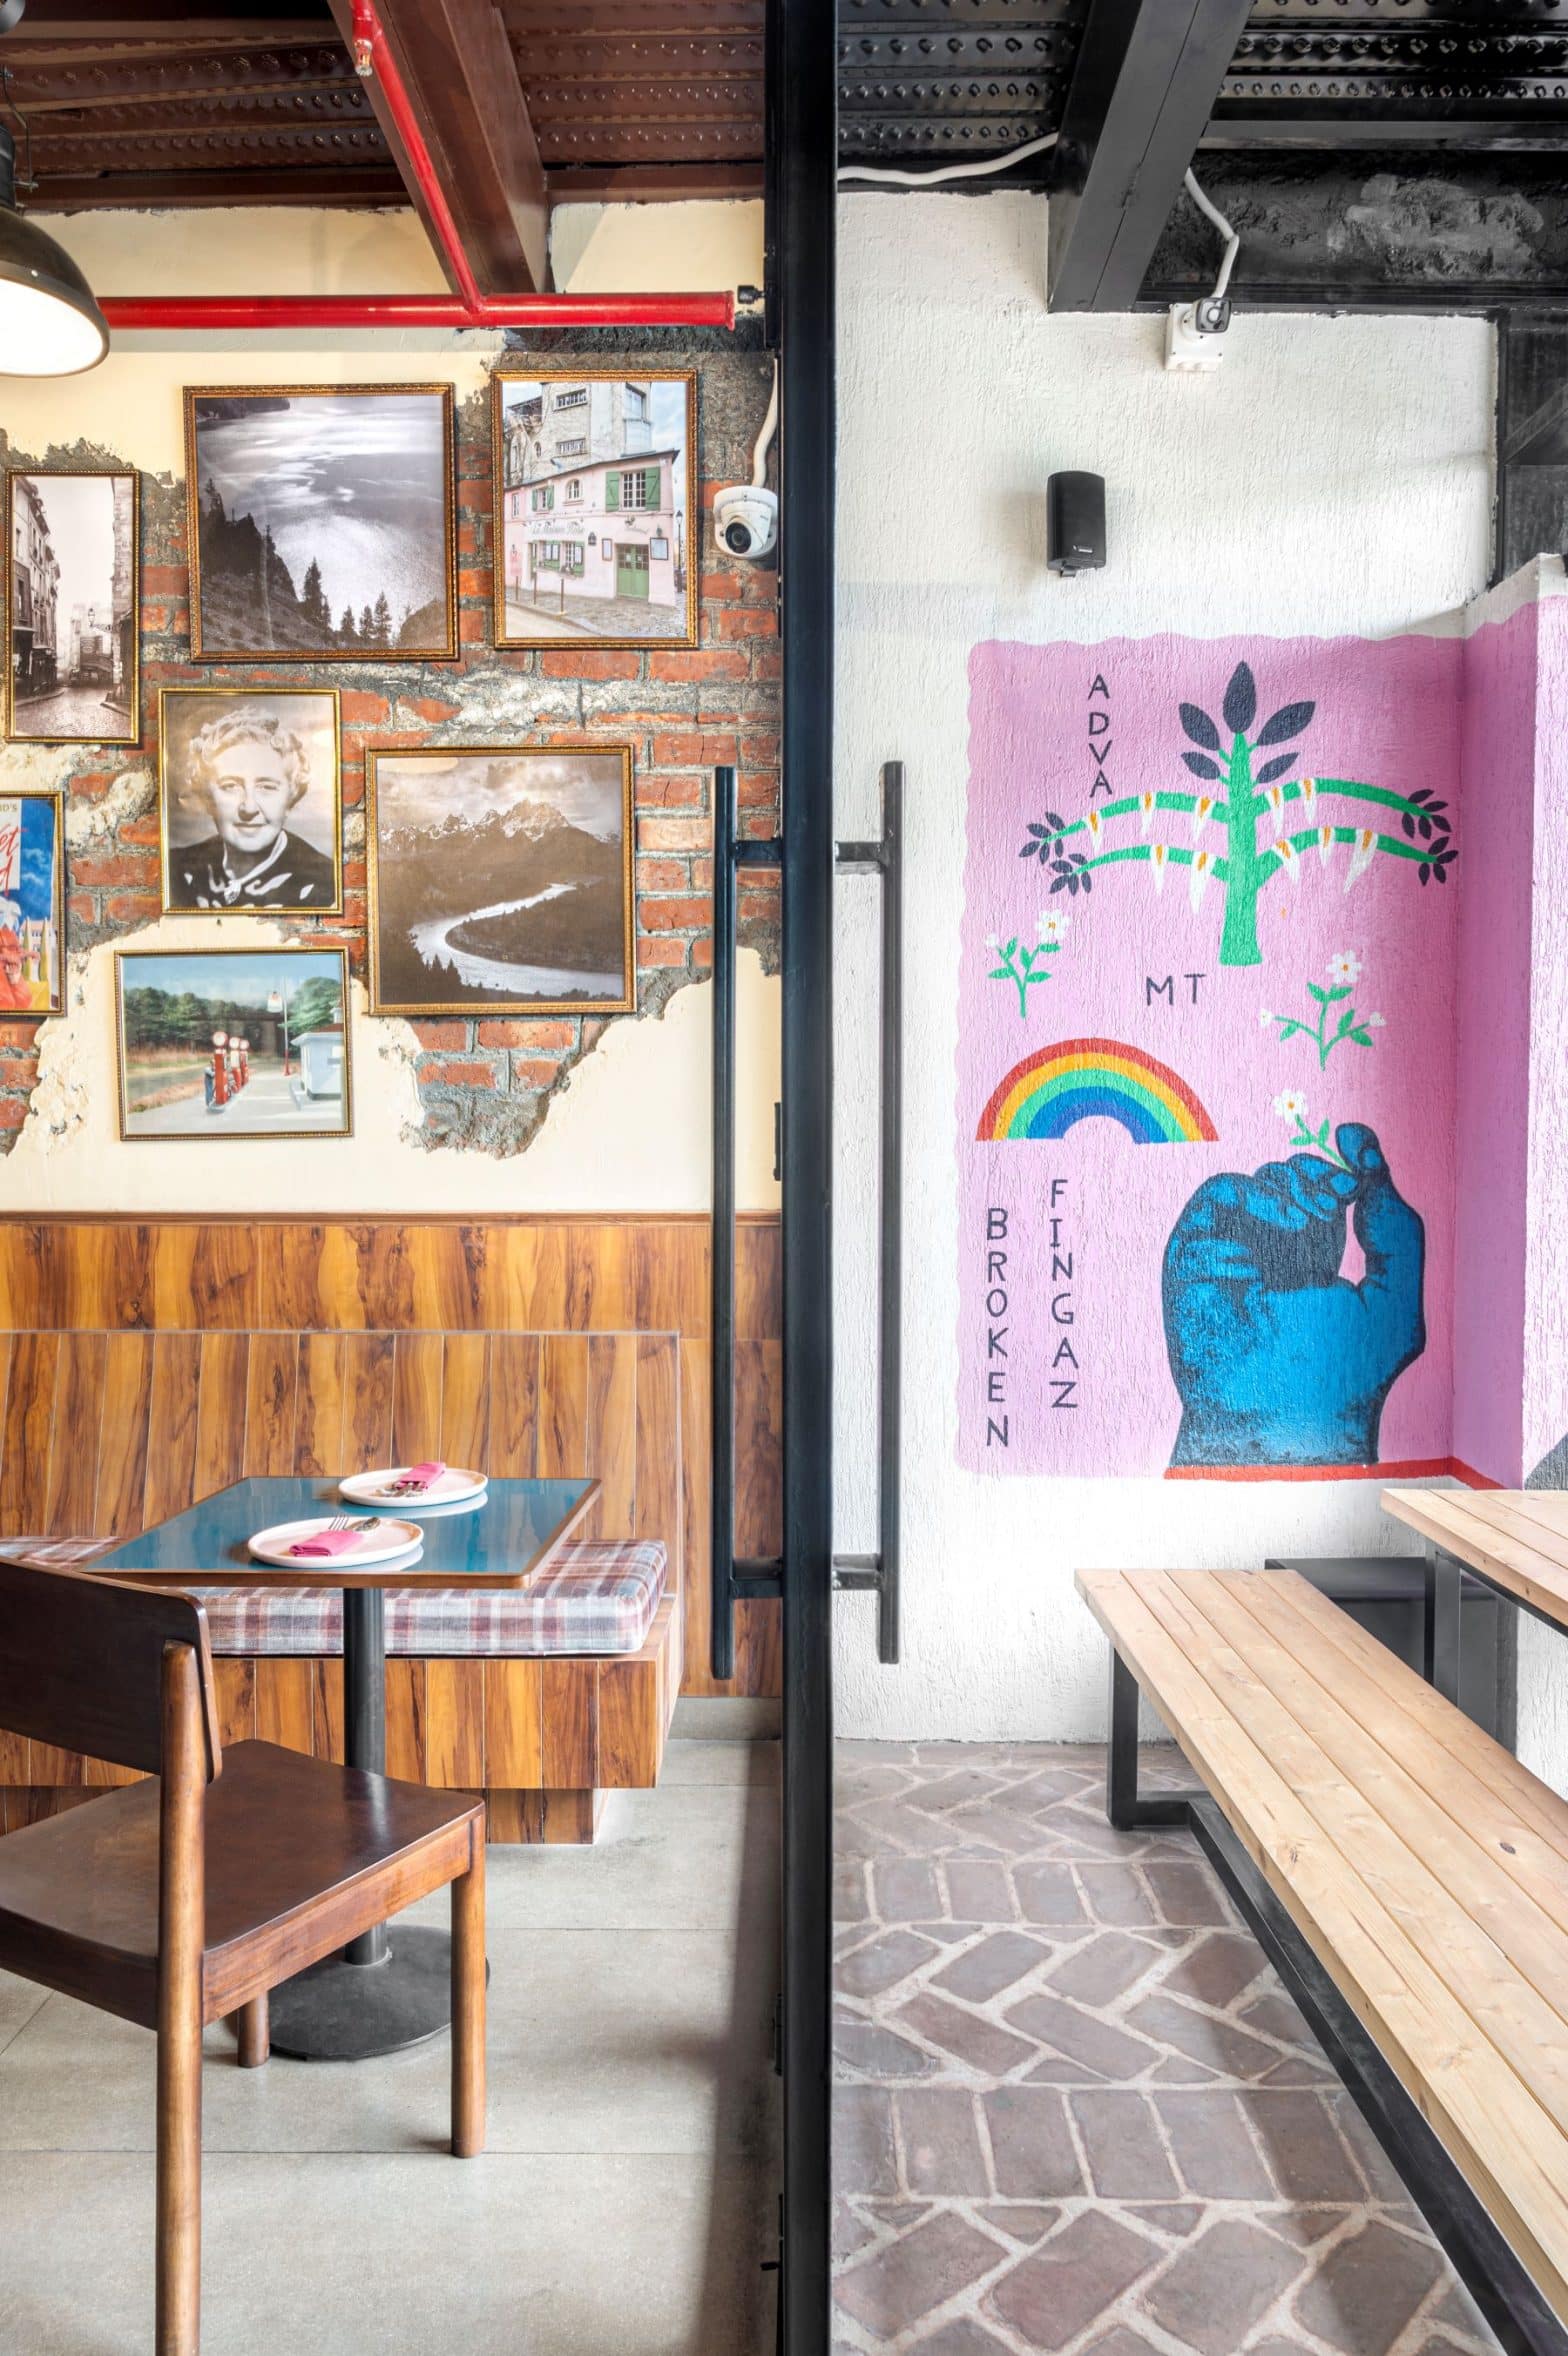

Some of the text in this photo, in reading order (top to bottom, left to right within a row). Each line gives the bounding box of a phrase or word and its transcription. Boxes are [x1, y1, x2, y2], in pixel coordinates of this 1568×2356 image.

[1088, 673, 1113, 798] ADVA
[986, 1207, 1009, 1448] BROKEN
[1049, 1179, 1079, 1409] FINGAZ
